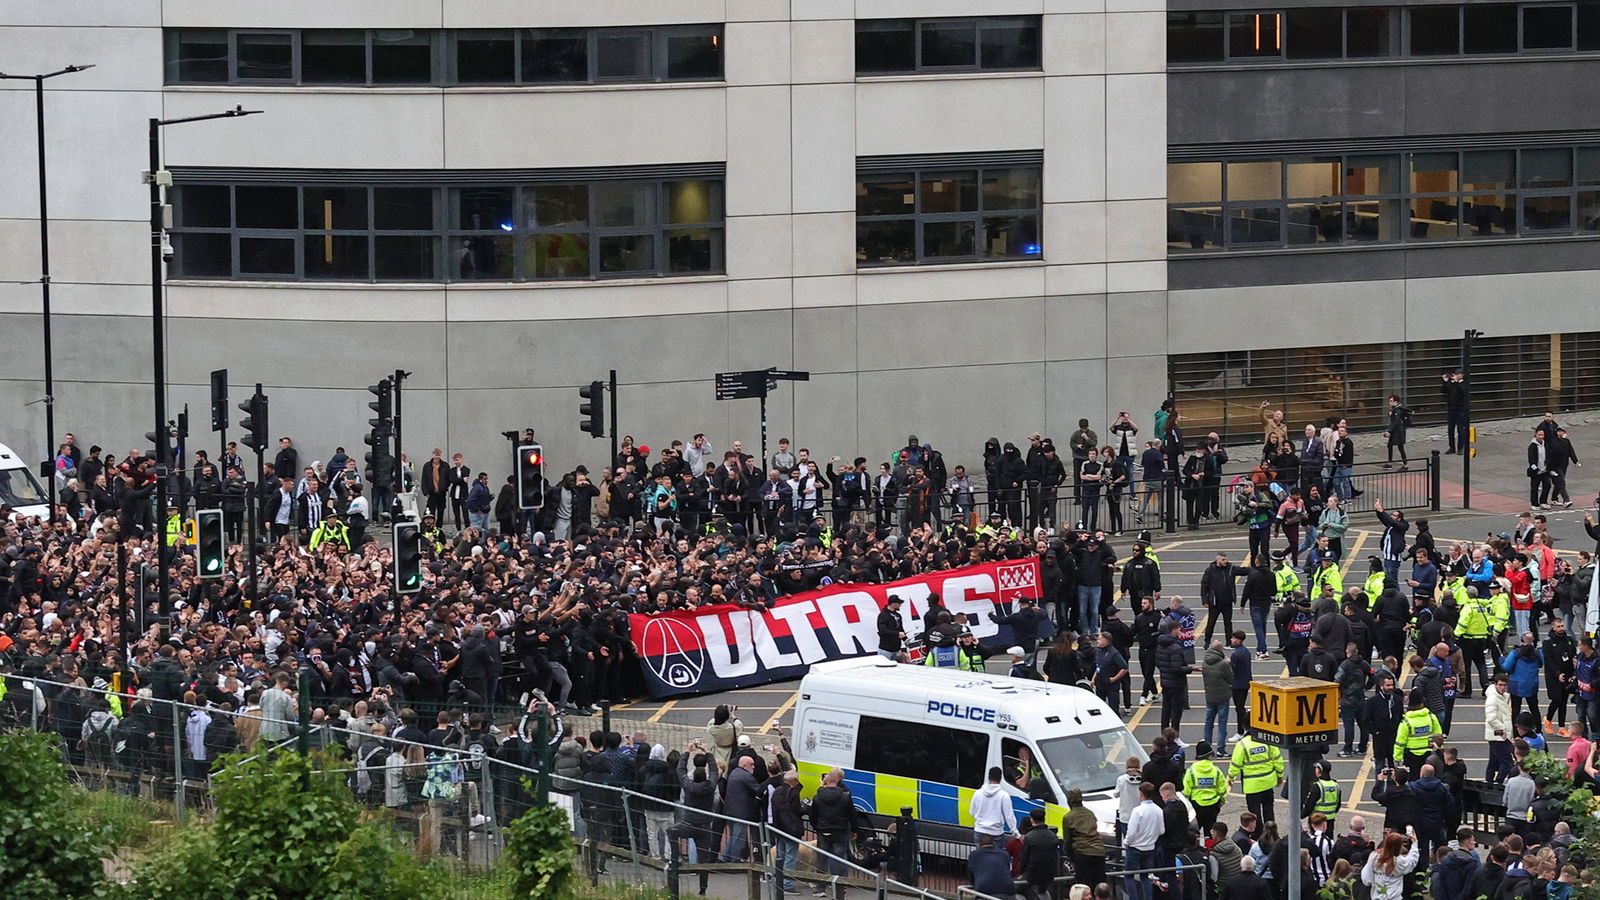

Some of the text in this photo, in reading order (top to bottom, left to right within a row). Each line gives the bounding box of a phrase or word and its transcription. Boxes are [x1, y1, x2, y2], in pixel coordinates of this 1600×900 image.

[696, 573, 1000, 679] ULTRAS
[927, 700, 996, 723] POLICE
[999, 713, 1012, 723] Y53
[1258, 691, 1280, 726] M
[1296, 693, 1328, 726] M
[1257, 732, 1281, 744] METRO
[1295, 733, 1328, 745] METRO
